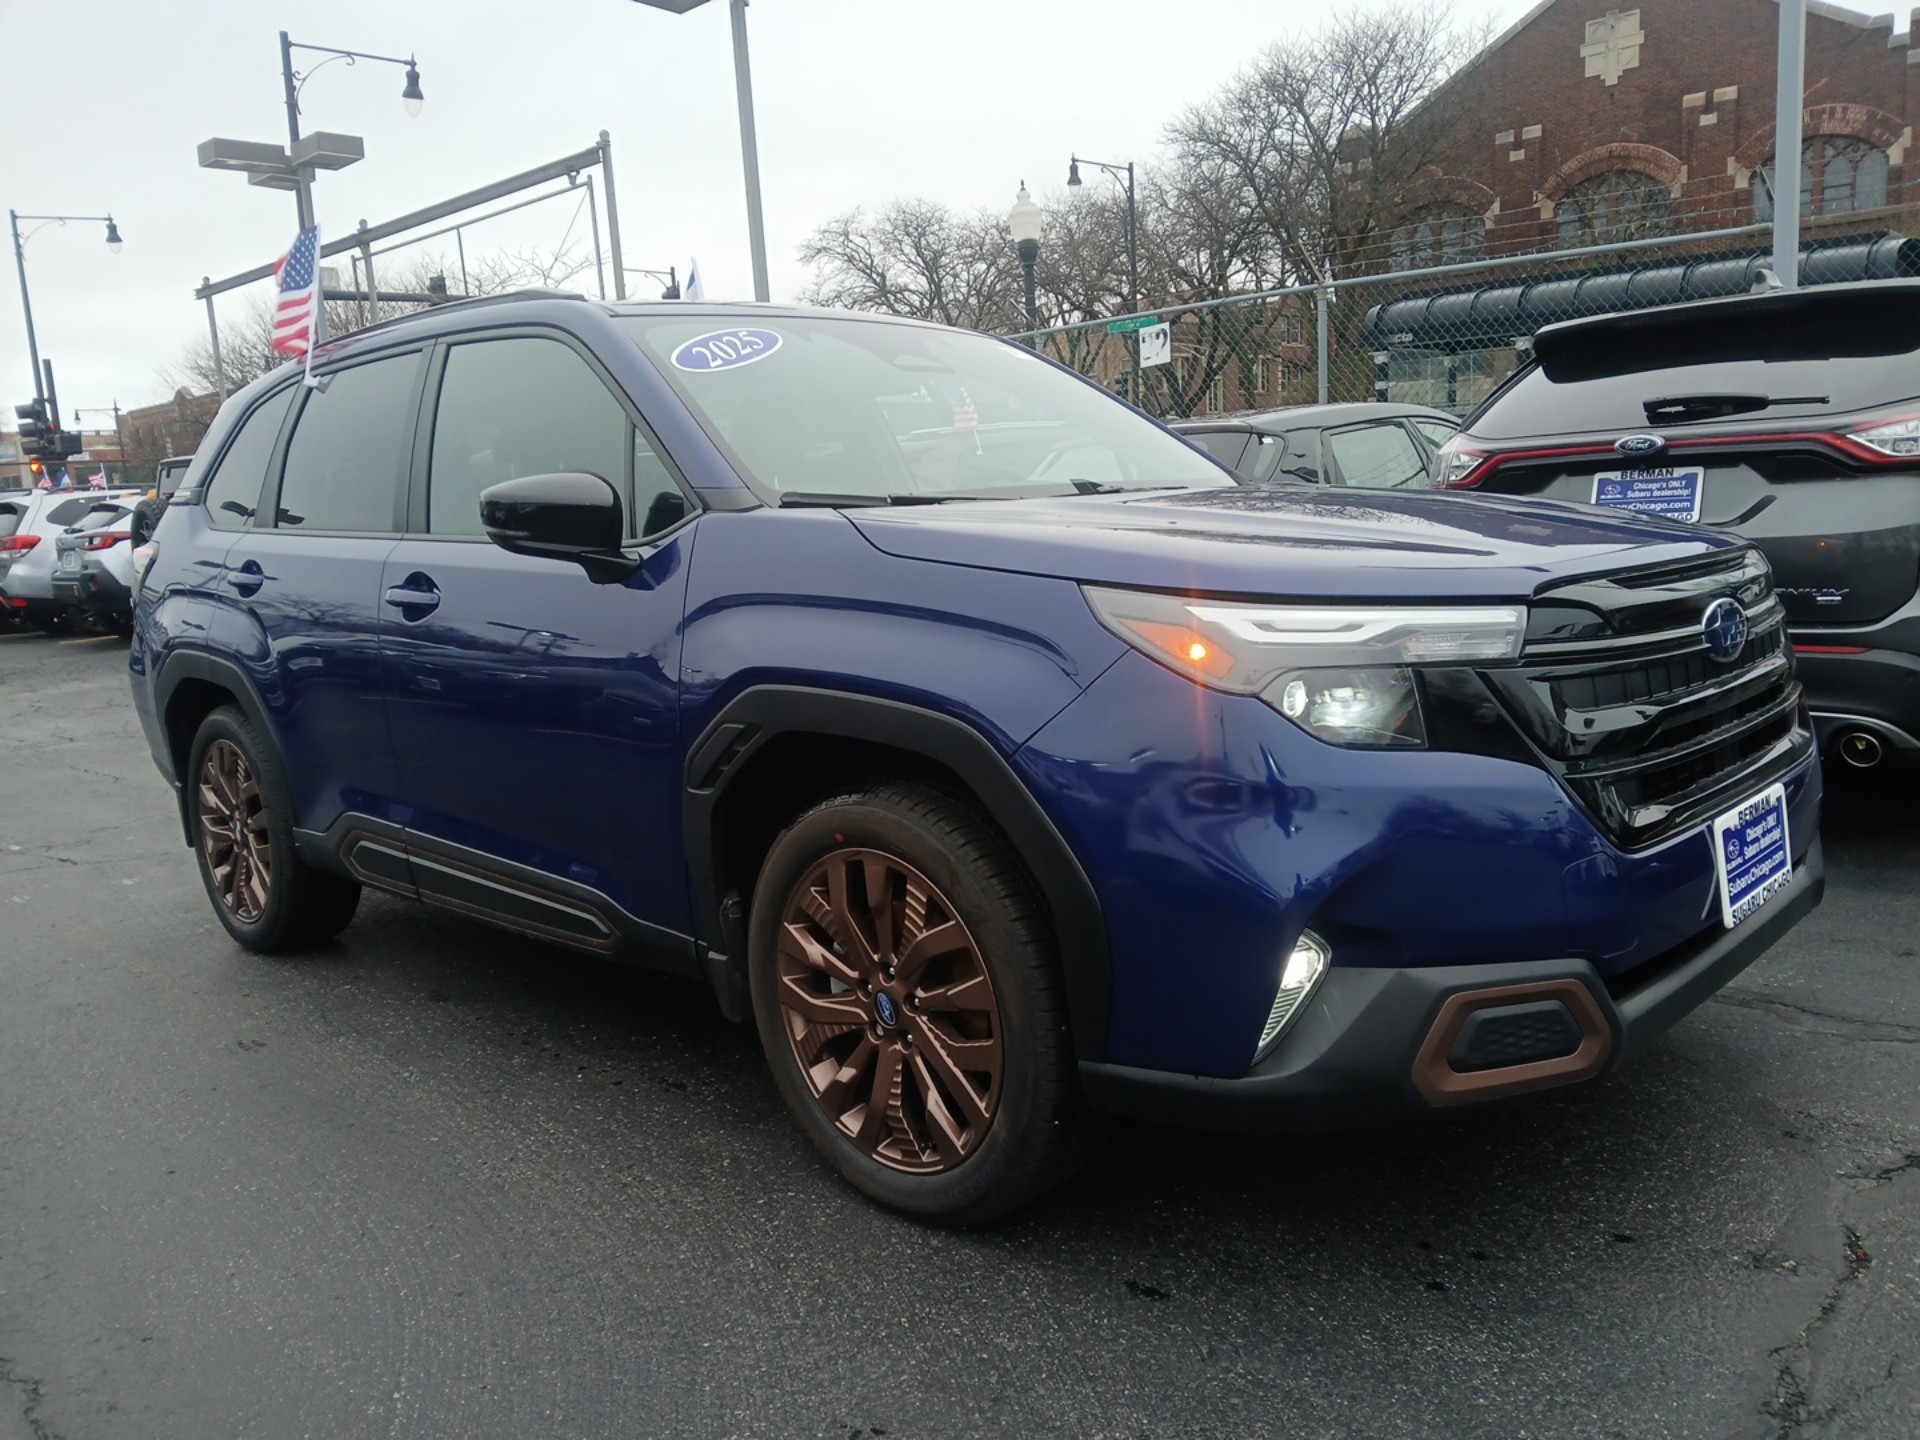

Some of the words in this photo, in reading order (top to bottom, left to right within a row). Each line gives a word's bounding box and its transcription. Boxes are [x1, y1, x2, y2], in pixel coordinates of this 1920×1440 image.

[692, 331, 764, 368] 2025
[1624, 439, 1650, 450] Ford
[1621, 468, 1674, 479] BERMAN
[1627, 490, 1651, 498] Subaru
[1652, 488, 1692, 498] dealership!
[1633, 481, 1667, 490] Chicago's
[1668, 480, 1687, 488] ONLY
[1738, 794, 1772, 827] BERMAN
[1728, 850, 1785, 896] SubaruChicago.com
[1732, 890, 1761, 925] SUBARU
[1762, 868, 1792, 901] CHICAGO
